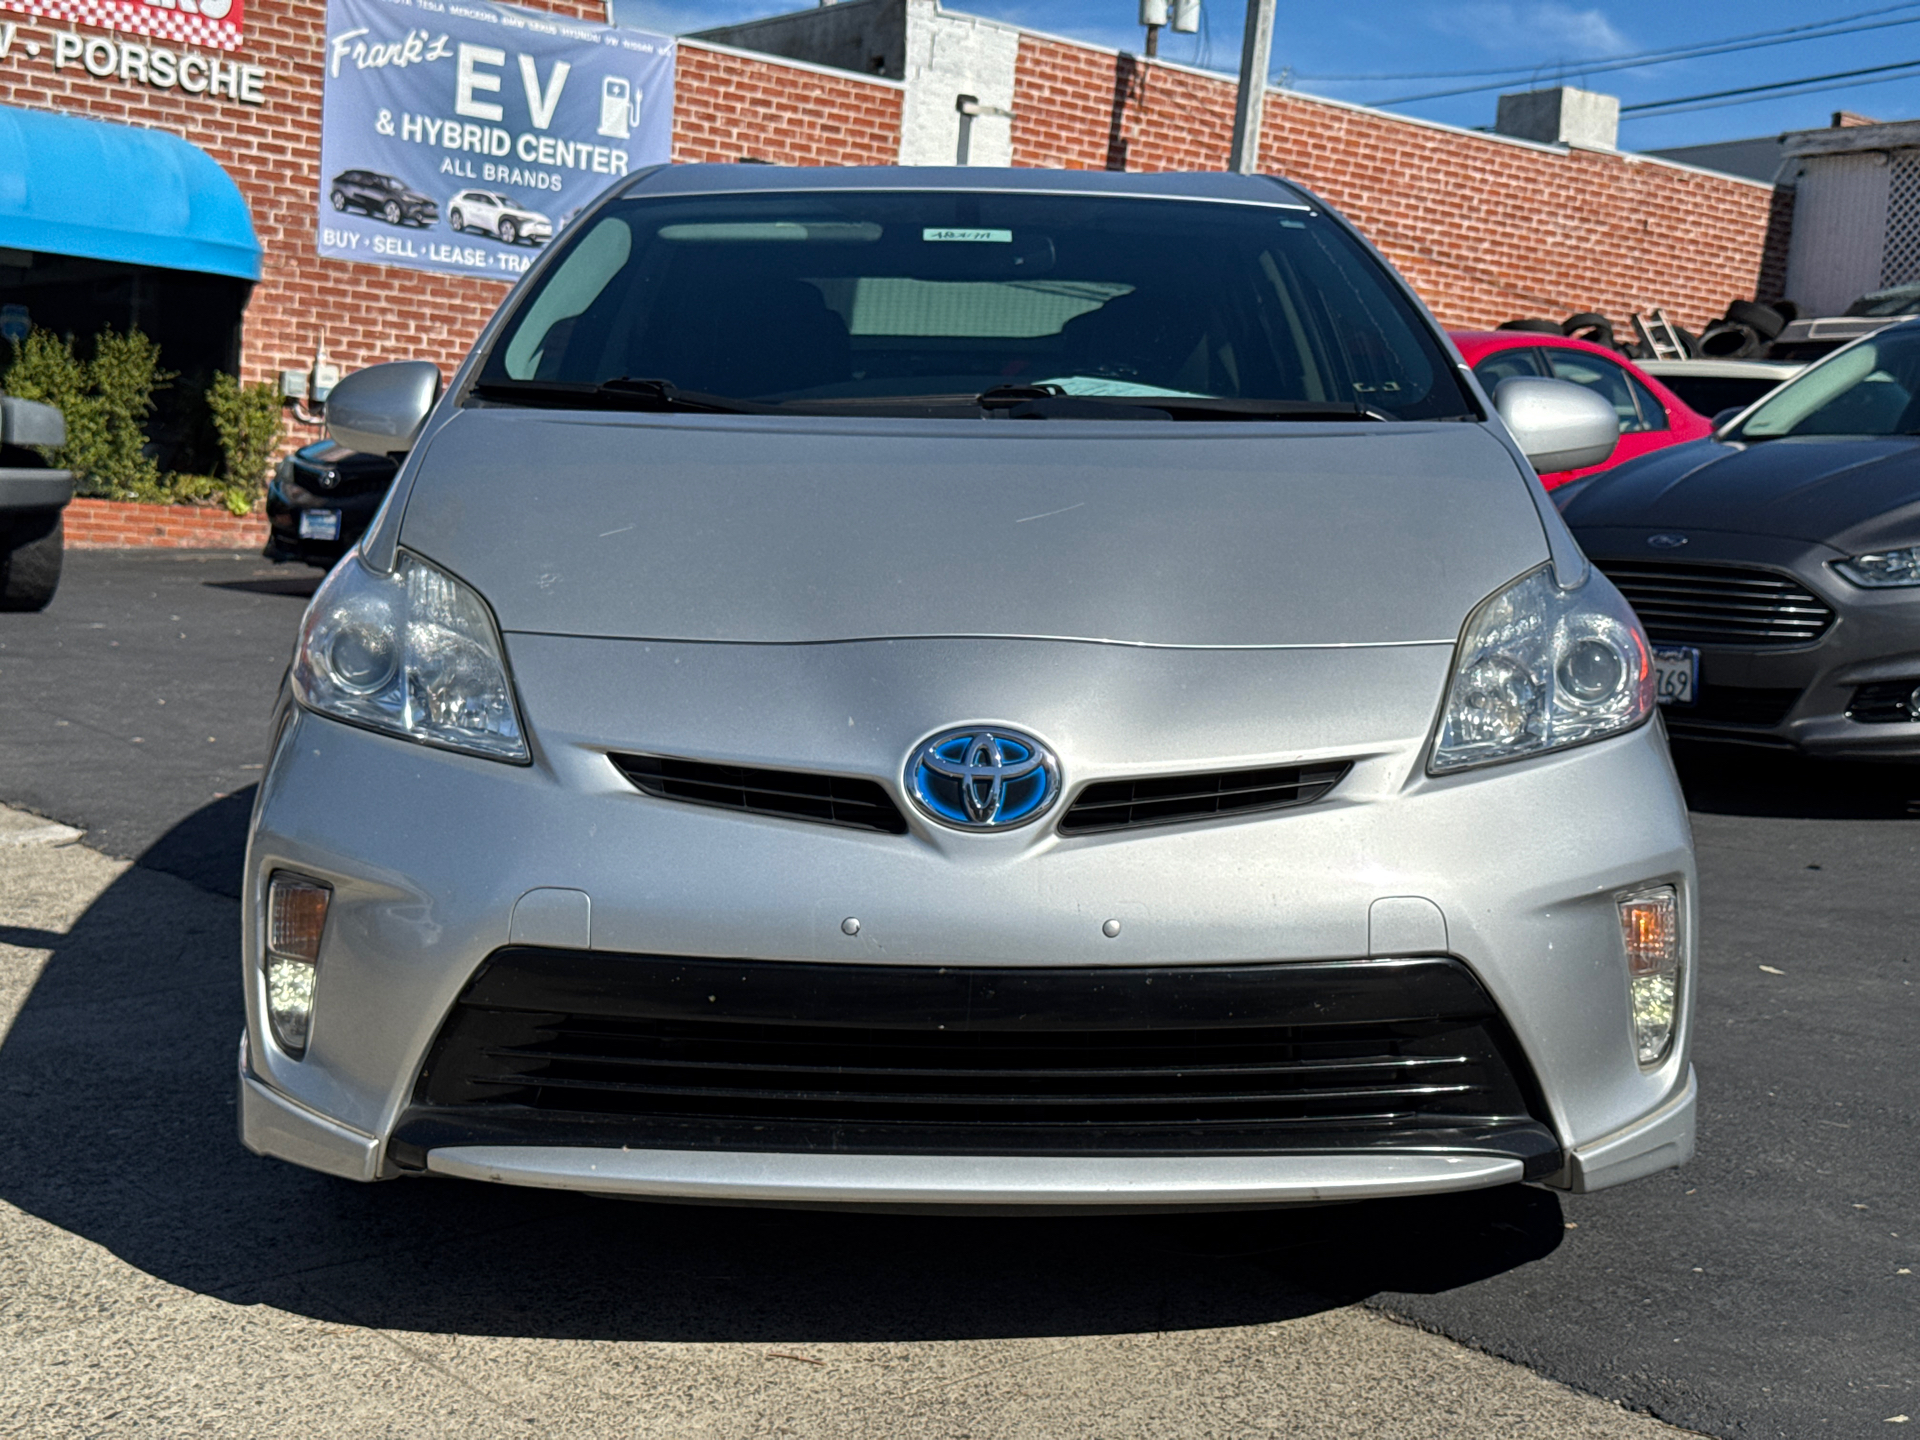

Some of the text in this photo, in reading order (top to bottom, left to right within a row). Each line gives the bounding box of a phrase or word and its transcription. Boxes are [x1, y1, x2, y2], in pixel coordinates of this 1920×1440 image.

[55, 31, 266, 103] PORSCHE
[330, 28, 454, 78] Frank's
[455, 42, 571, 129] EV
[375, 108, 629, 175] & HYBRID CENTER
[440, 157, 562, 192] ALL BRANDS
[322, 228, 537, 273] BUY SELL LEASE TRA
